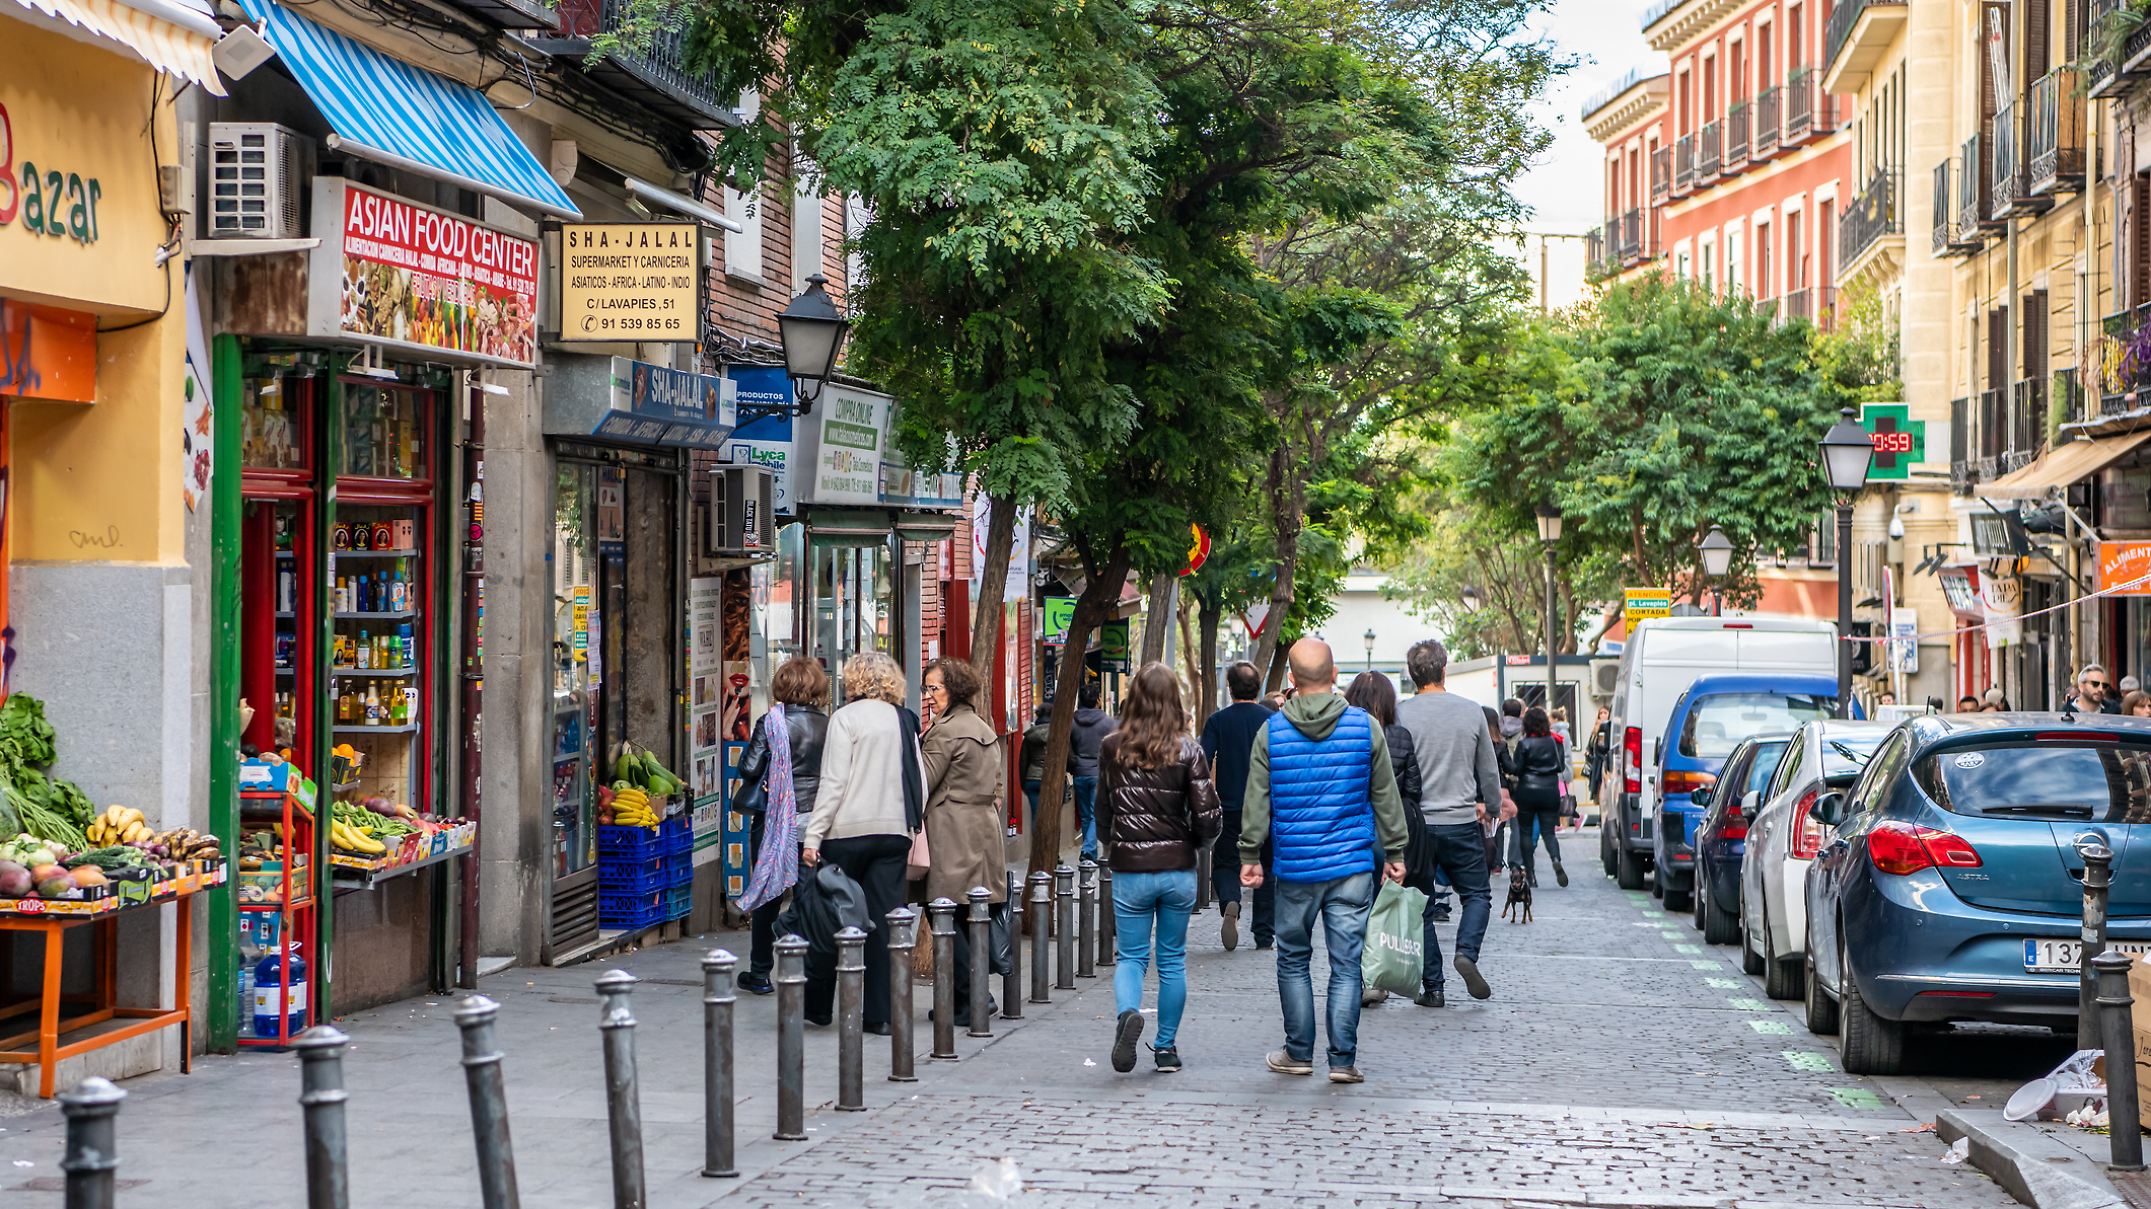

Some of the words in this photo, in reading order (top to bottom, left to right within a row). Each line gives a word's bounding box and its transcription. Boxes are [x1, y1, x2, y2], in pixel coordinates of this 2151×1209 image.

[347, 191, 410, 245] ASIAN
[414, 209, 468, 258] FOOD
[471, 226, 533, 277] CENTER
[569, 231, 693, 248] SHA-JALAL
[571, 255, 632, 268] SUPERMARKET
[633, 255, 639, 268] Y
[641, 255, 690, 268] CARNICERIA
[571, 276, 607, 288] ASIATICOS
[612, 276, 637, 288] AFRICA
[642, 276, 666, 288] LATINO
[671, 276, 690, 288] INDIO
[601, 318, 616, 329] 91
[620, 318, 643, 329] 539
[646, 318, 661, 329] 85
[665, 318, 680, 329] 65
[651, 368, 704, 410] SHA-JALAL
[736, 391, 784, 400] PRODUCTOS
[835, 397, 856, 422] COMPRA
[1868, 433, 1909, 451] 0:59
[752, 447, 785, 465] Lyca
[746, 501, 754, 518] BLACK
[1991, 583, 2017, 593] TAPA
[17, 898, 46, 913] TROPS
